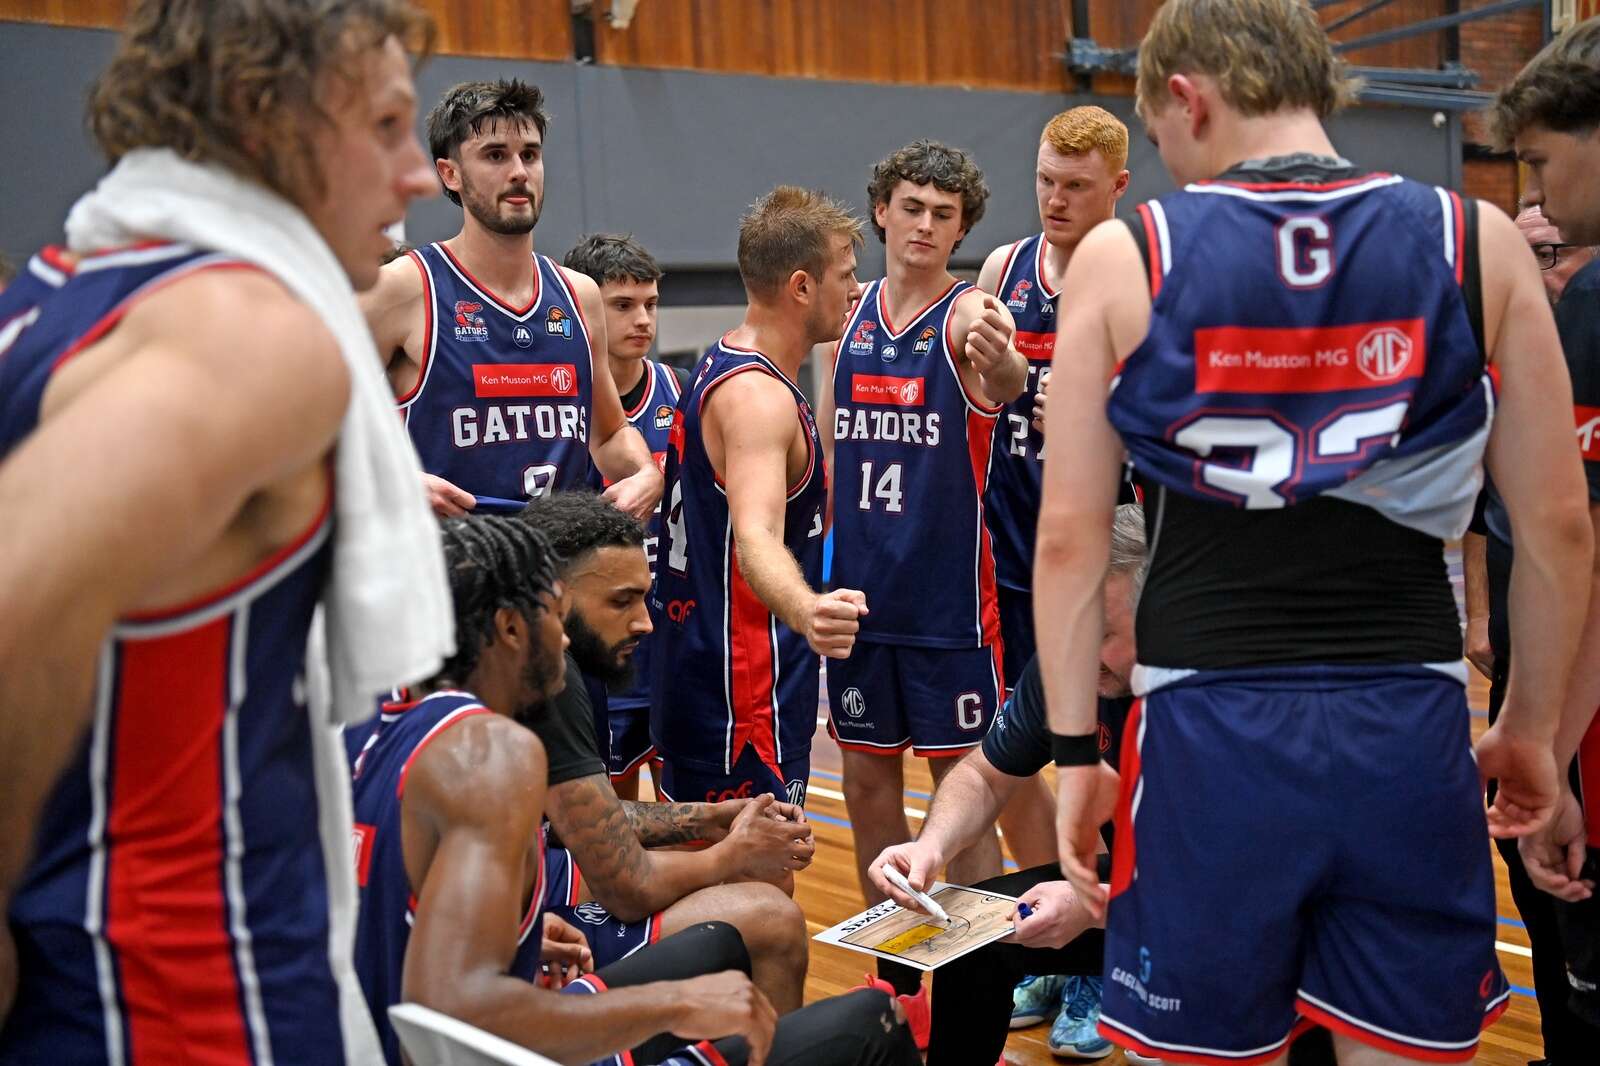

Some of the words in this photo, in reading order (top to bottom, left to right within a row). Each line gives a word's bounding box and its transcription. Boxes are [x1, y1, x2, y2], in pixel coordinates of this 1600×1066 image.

[1278, 216, 1332, 286] G
[455, 327, 488, 335] GATORS
[1209, 351, 1242, 369] Ken
[1245, 351, 1311, 369] Muston
[1315, 348, 1349, 367] MG
[1360, 331, 1411, 378] MG
[481, 376, 499, 385] Ken
[501, 375, 531, 385] Muston
[533, 375, 548, 385] MG
[552, 369, 572, 392] MG
[856, 383, 869, 393] Ken
[452, 405, 586, 448] GATORS
[834, 407, 940, 446] GATORS
[859, 461, 903, 512] 14
[842, 689, 865, 716] MG
[957, 693, 982, 730] G
